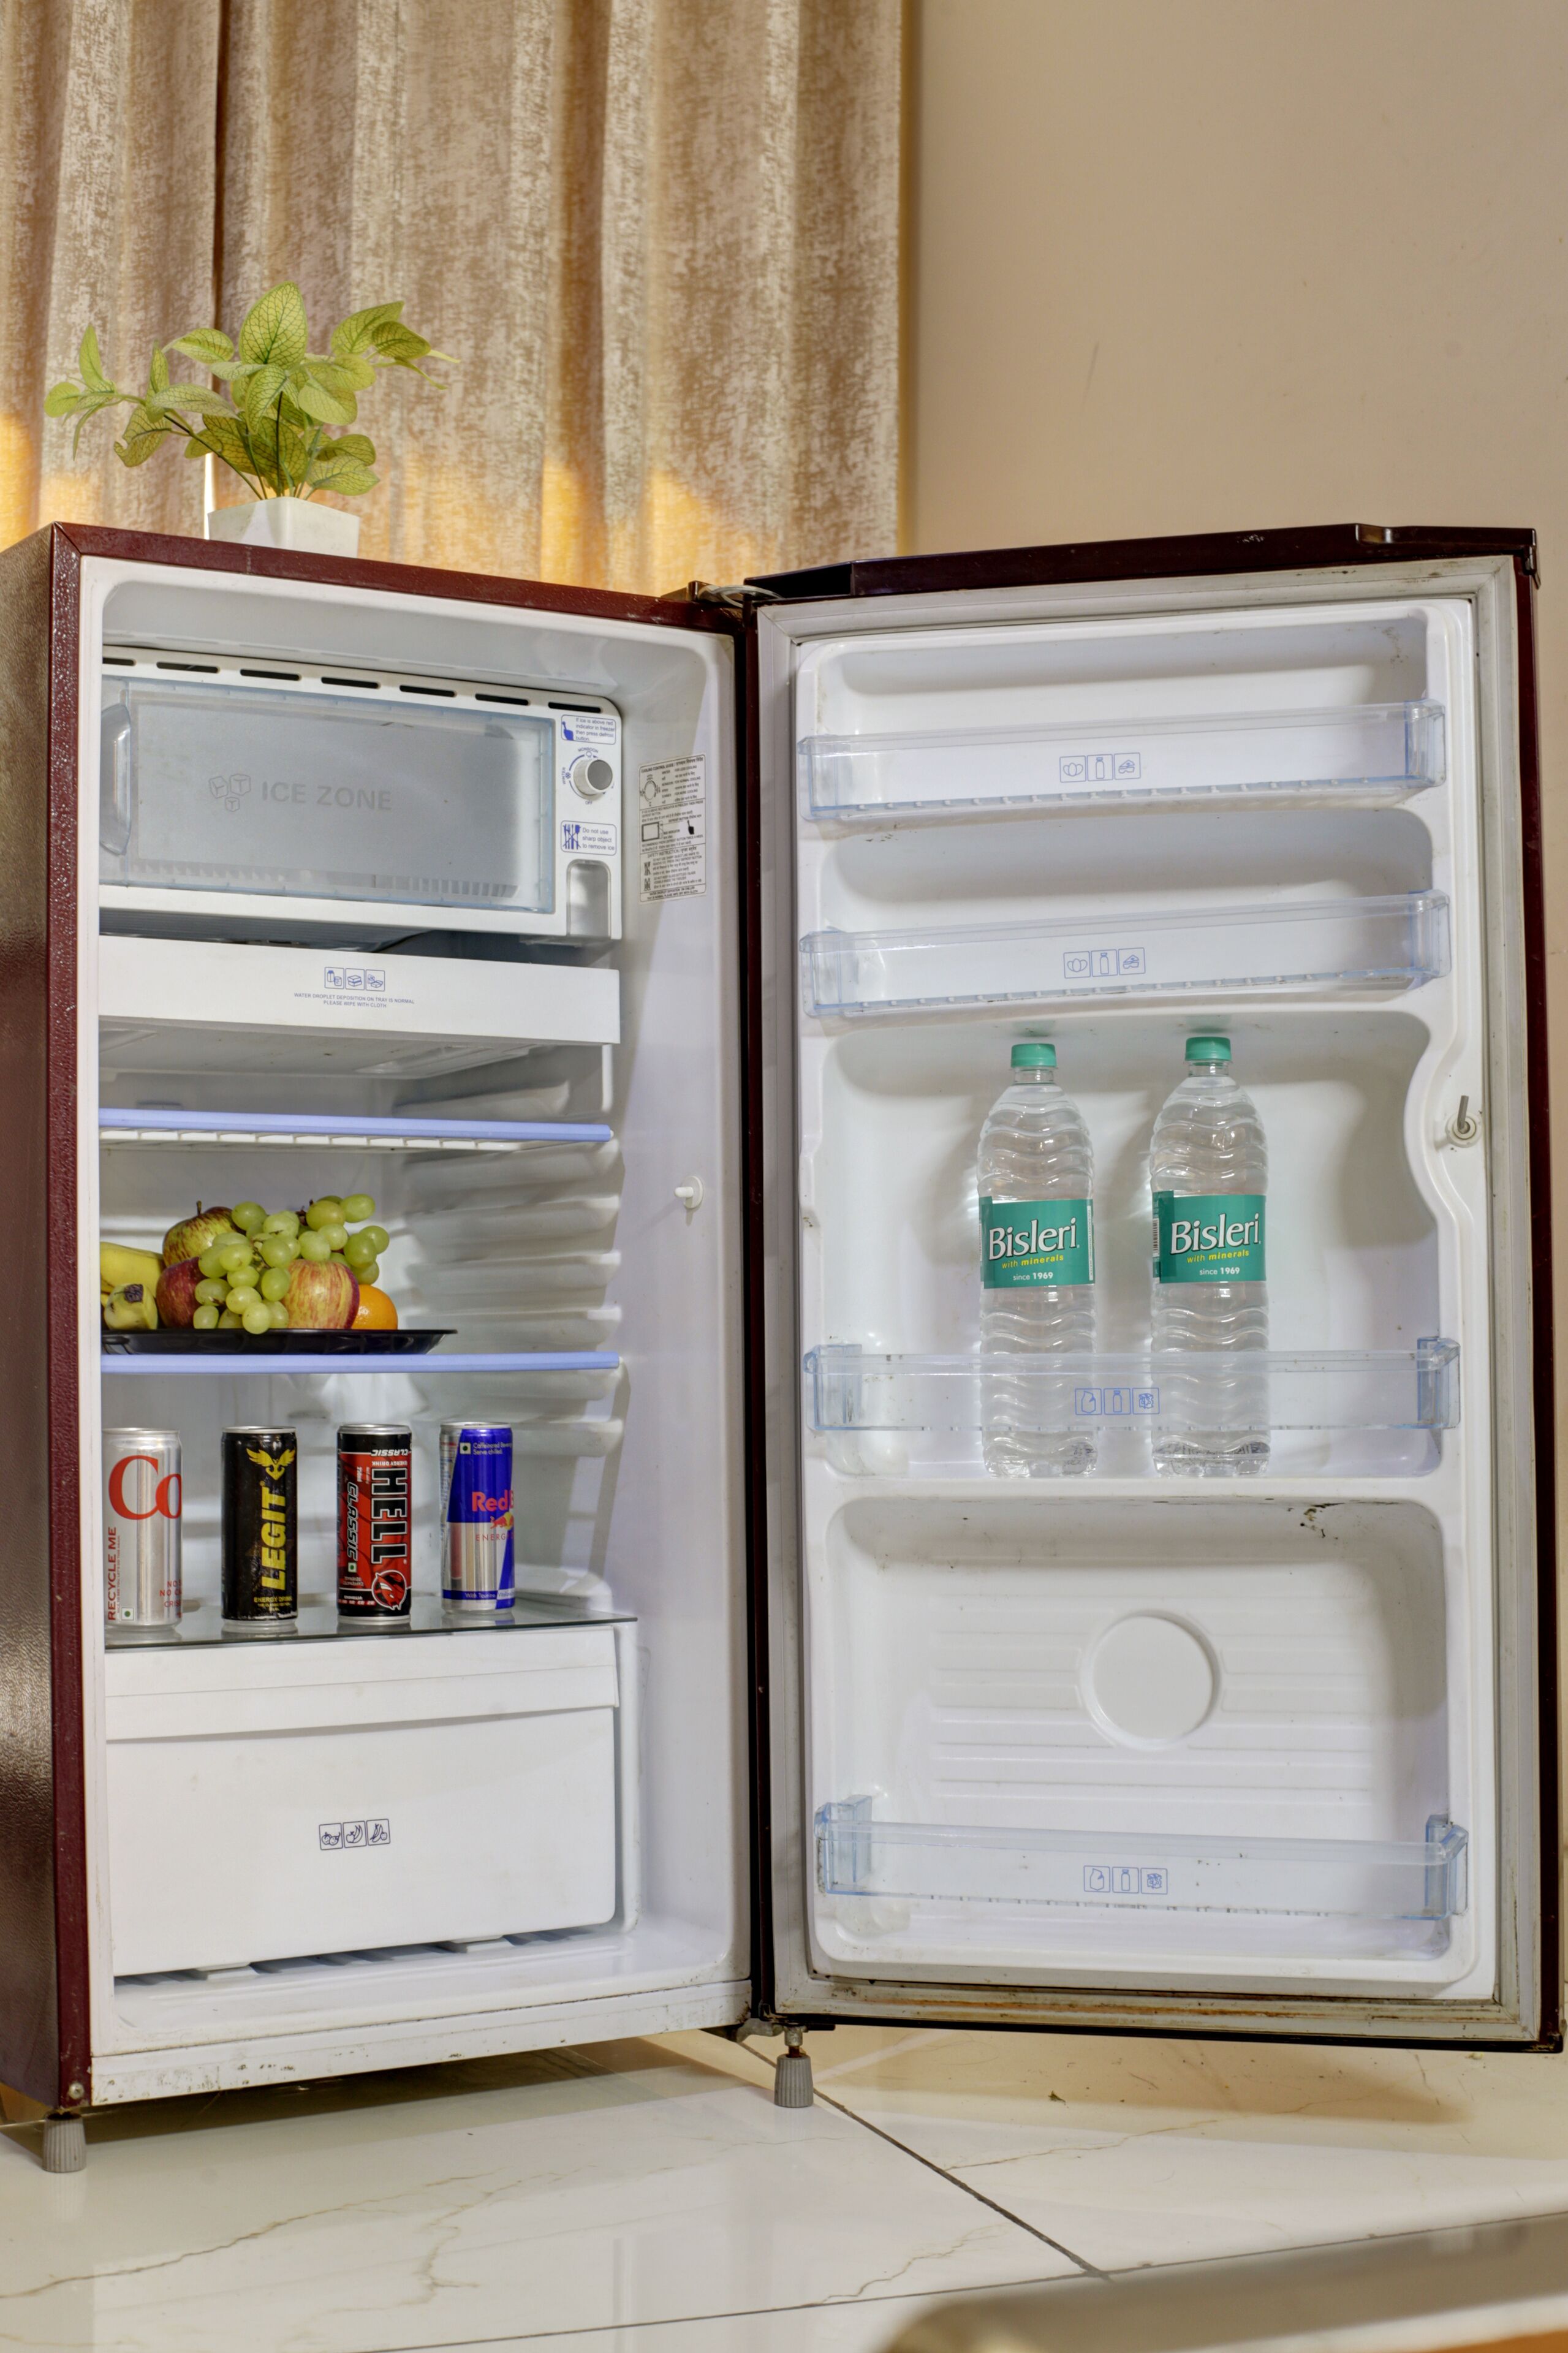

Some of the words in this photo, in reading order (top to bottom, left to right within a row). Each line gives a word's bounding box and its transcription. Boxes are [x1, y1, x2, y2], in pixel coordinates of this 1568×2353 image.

[262, 781, 306, 804] ICE
[316, 785, 392, 811] ZONE
[989, 1216, 1077, 1260] Bisleri
[1170, 1213, 1259, 1255] Bisleri
[1002, 1260, 1018, 1269] with
[1021, 1254, 1064, 1266] minerals
[1187, 1254, 1205, 1263] with
[1208, 1249, 1249, 1260] minerals
[347, 1482, 358, 1561] CLASSIC
[371, 1468, 407, 1564] HELL
[108, 1527, 116, 1550] ME
[262, 1487, 286, 1591] LEGIT
